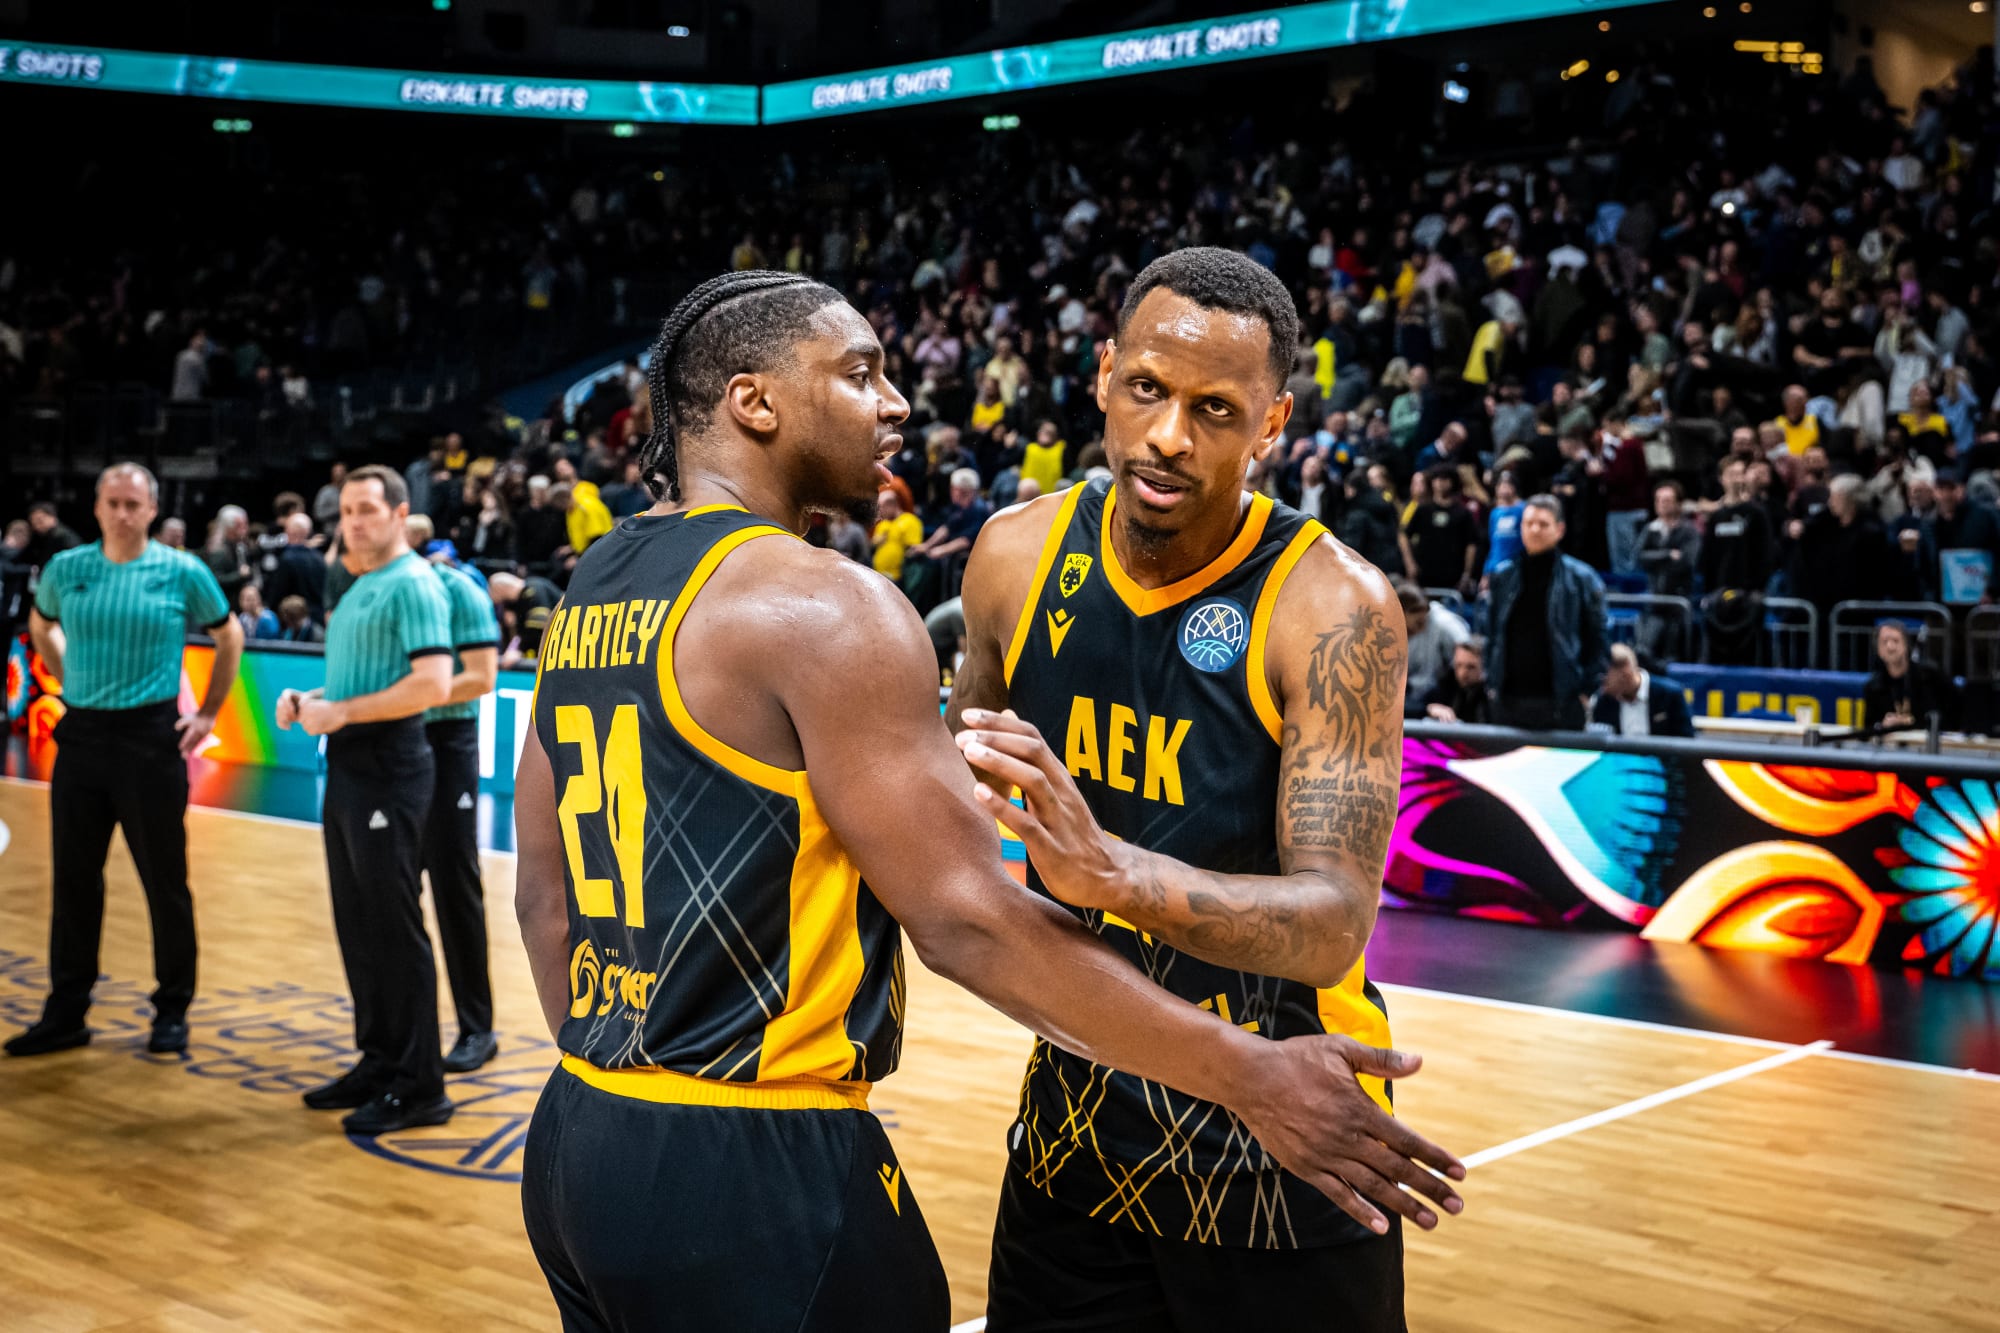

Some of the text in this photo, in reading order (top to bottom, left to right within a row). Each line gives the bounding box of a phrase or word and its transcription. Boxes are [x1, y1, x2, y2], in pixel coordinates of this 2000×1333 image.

[1205, 18, 1280, 54] SHOTS
[17, 49, 103, 80] SHOTS
[513, 85, 588, 112] SHOTS
[545, 599, 670, 672] BARTLEY
[1065, 695, 1193, 806] AEK
[555, 704, 648, 929] 24
